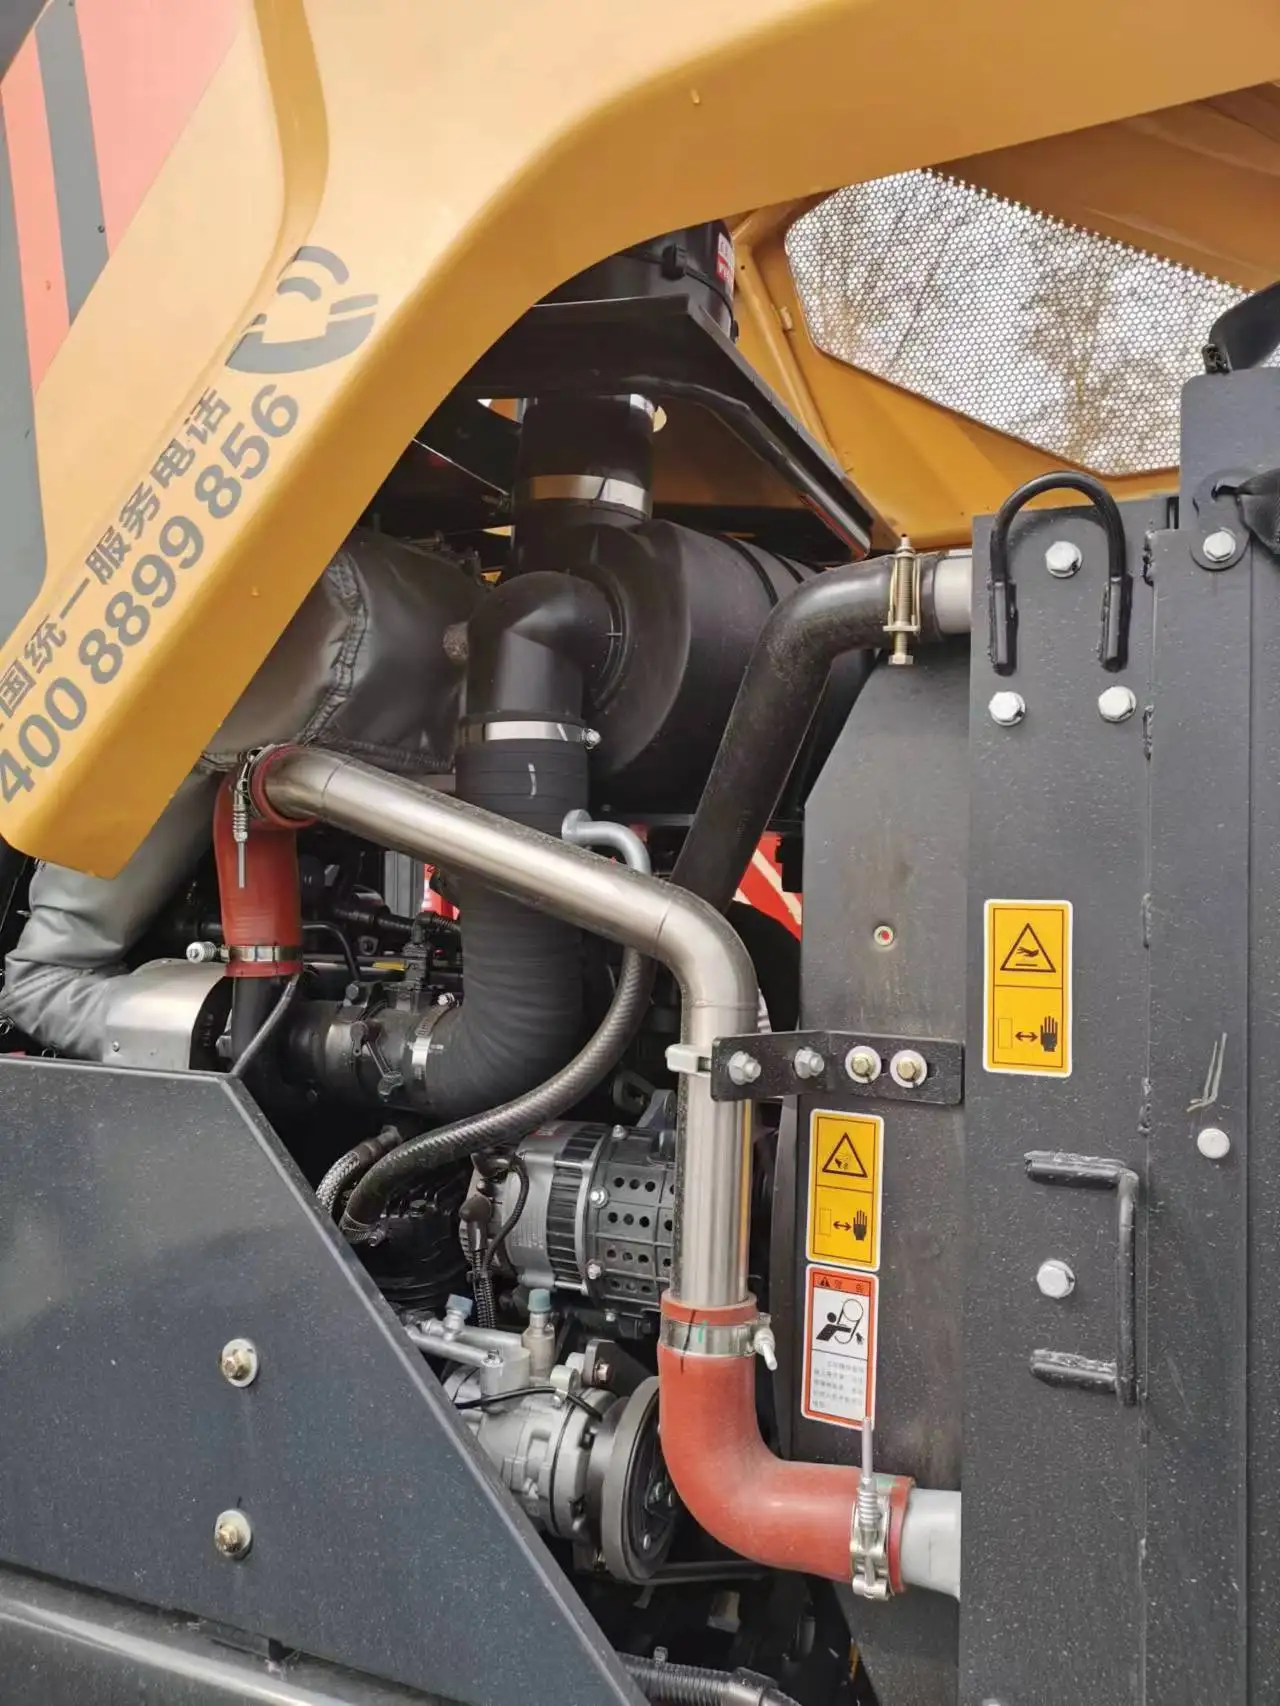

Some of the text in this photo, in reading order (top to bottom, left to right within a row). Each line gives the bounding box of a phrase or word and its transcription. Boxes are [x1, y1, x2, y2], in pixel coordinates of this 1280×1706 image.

[0, 386, 231, 731] 国统一服务电话
[0, 384, 299, 804] 400 8899 856
